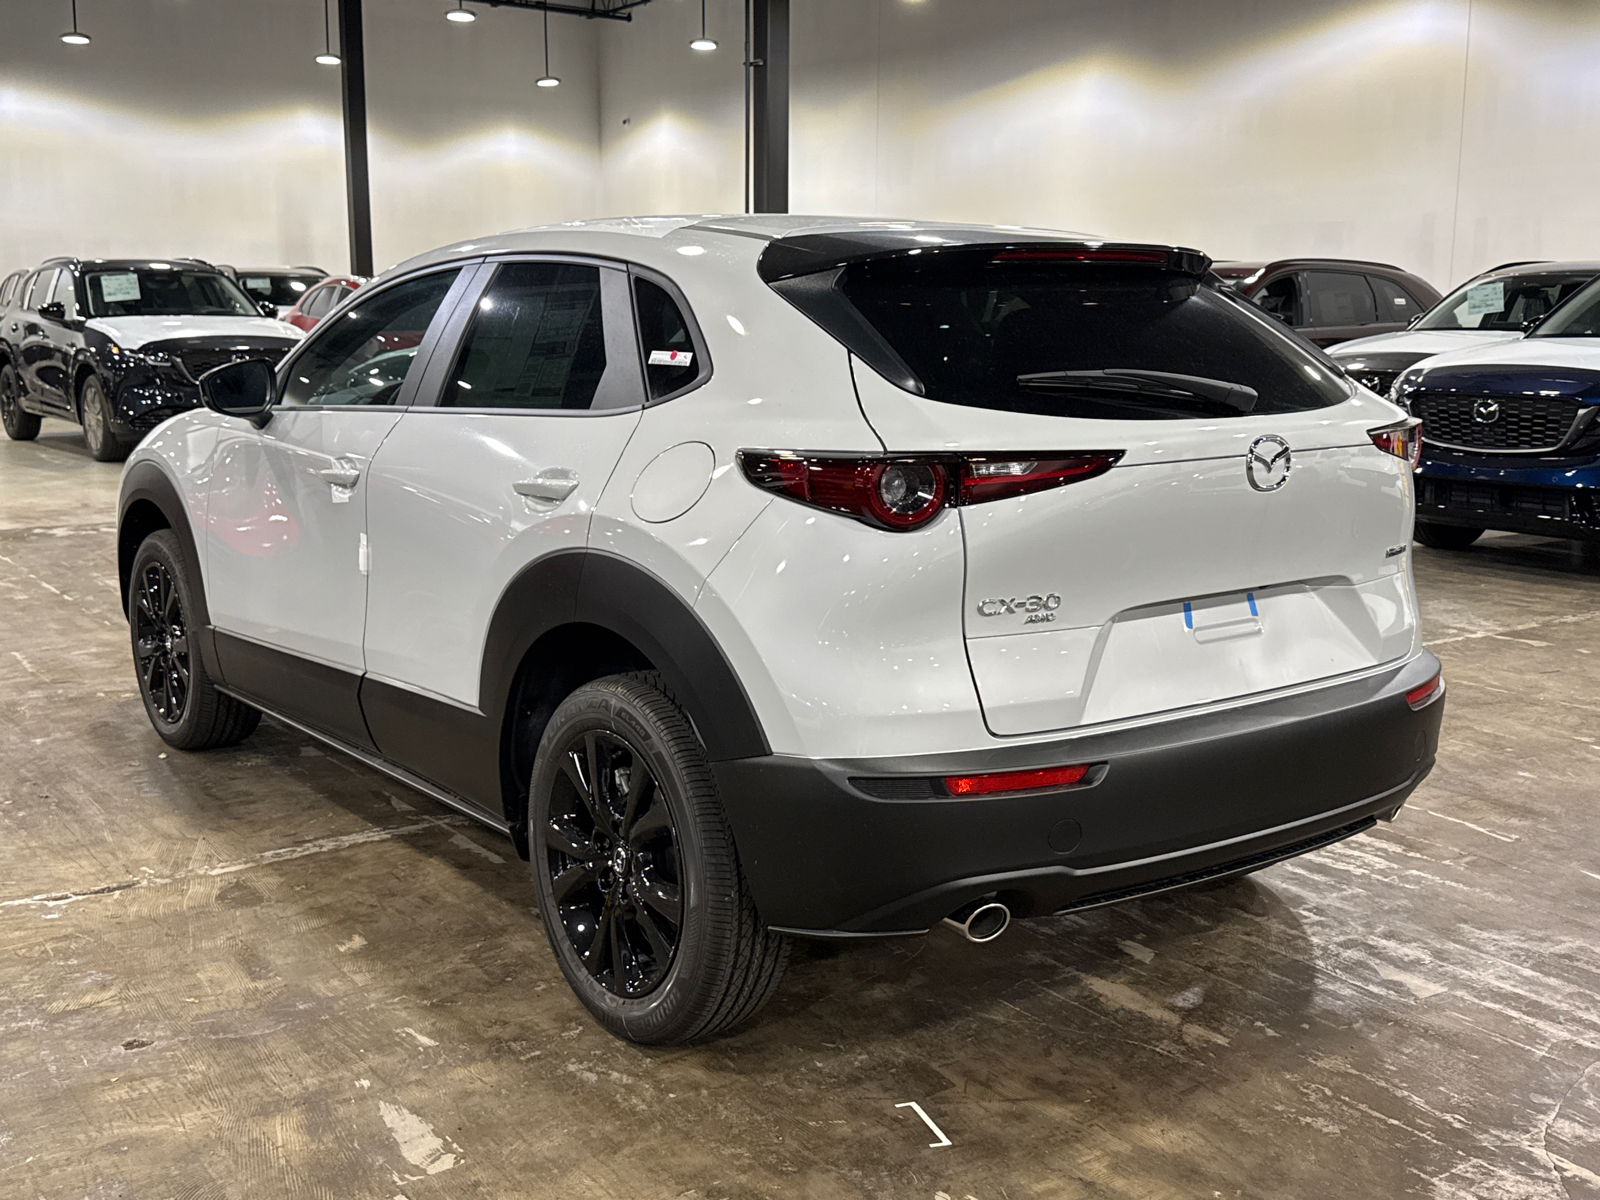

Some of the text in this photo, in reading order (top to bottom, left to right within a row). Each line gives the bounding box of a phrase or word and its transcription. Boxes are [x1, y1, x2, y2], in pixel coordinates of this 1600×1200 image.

[977, 592, 1061, 617] CX-30
[1024, 612, 1056, 625] AWD
[620, 711, 646, 737] EL440
[600, 985, 681, 1033] BRIDGESONE
